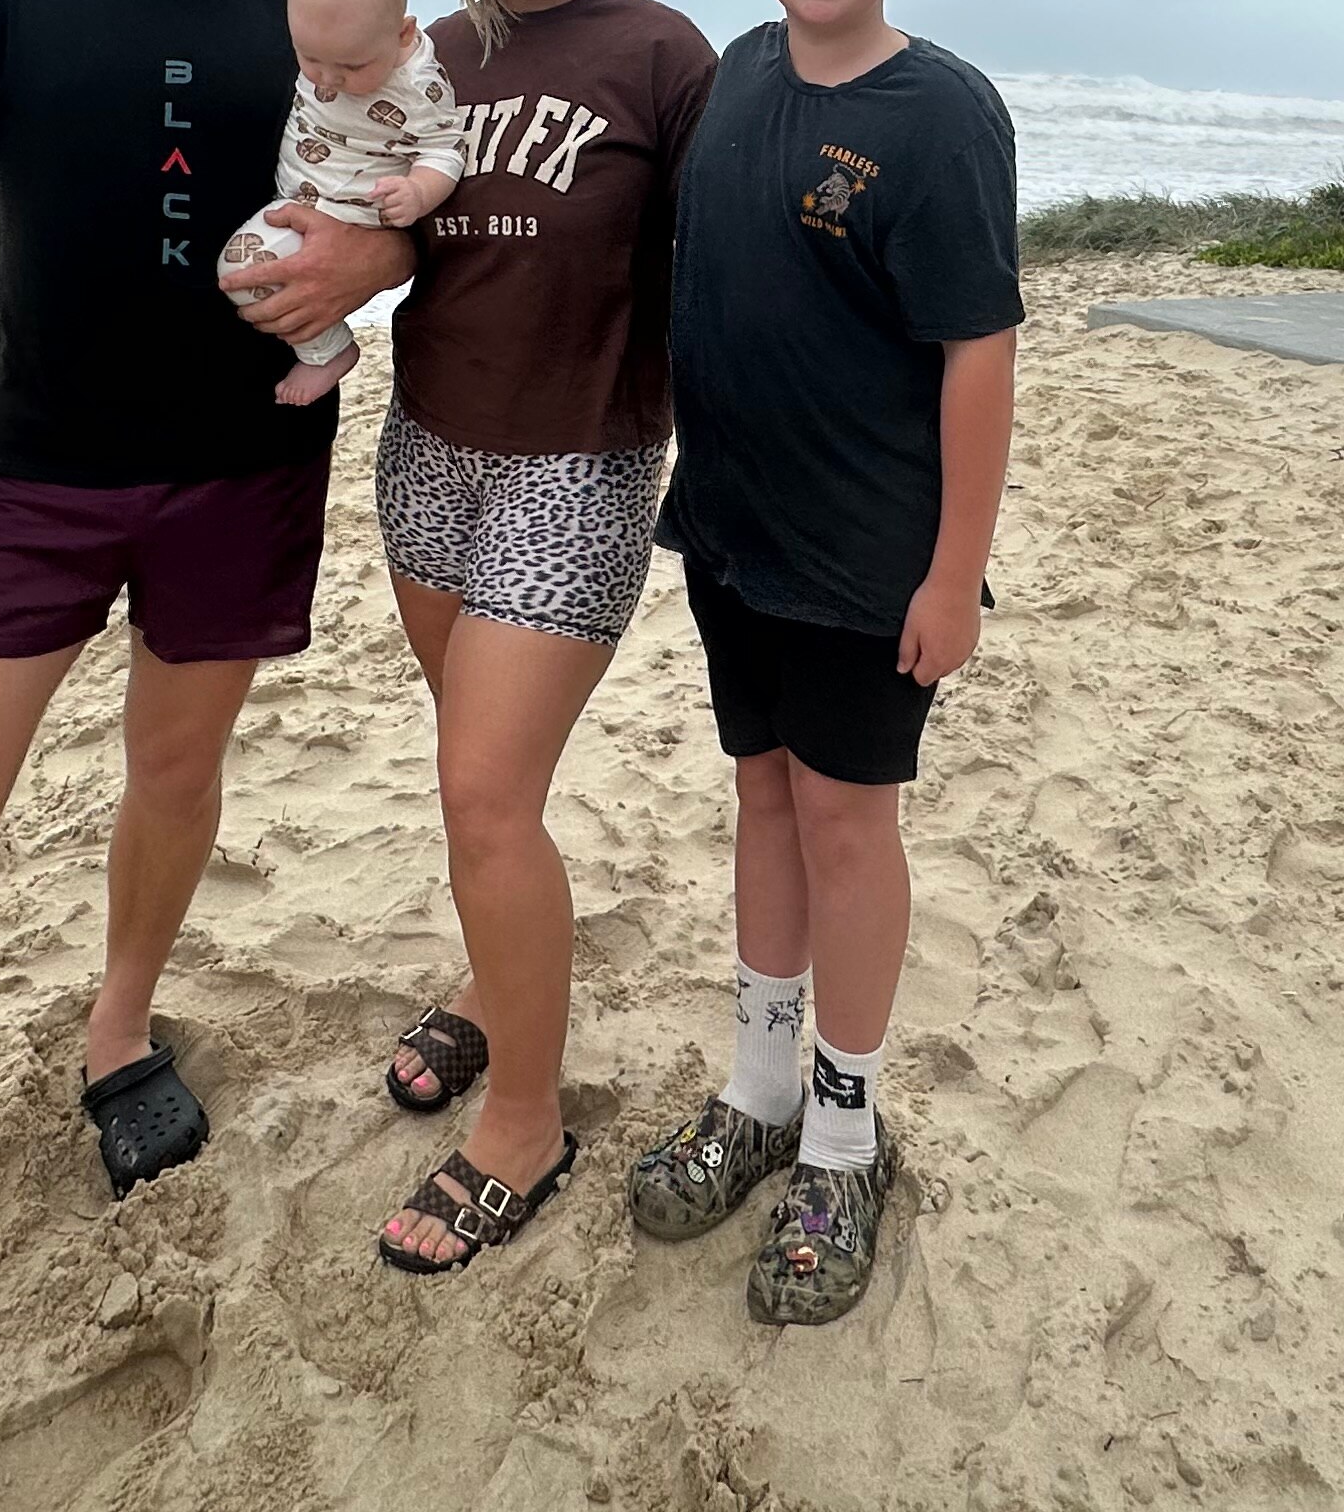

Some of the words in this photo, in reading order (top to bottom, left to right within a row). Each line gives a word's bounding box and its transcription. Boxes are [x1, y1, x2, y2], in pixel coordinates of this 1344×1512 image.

[161, 59, 193, 266] BLACK
[819, 144, 881, 178] FEARLESS
[434, 216, 479, 236] EST.
[488, 215, 538, 236] 2013
[799, 212, 824, 229] WILD
